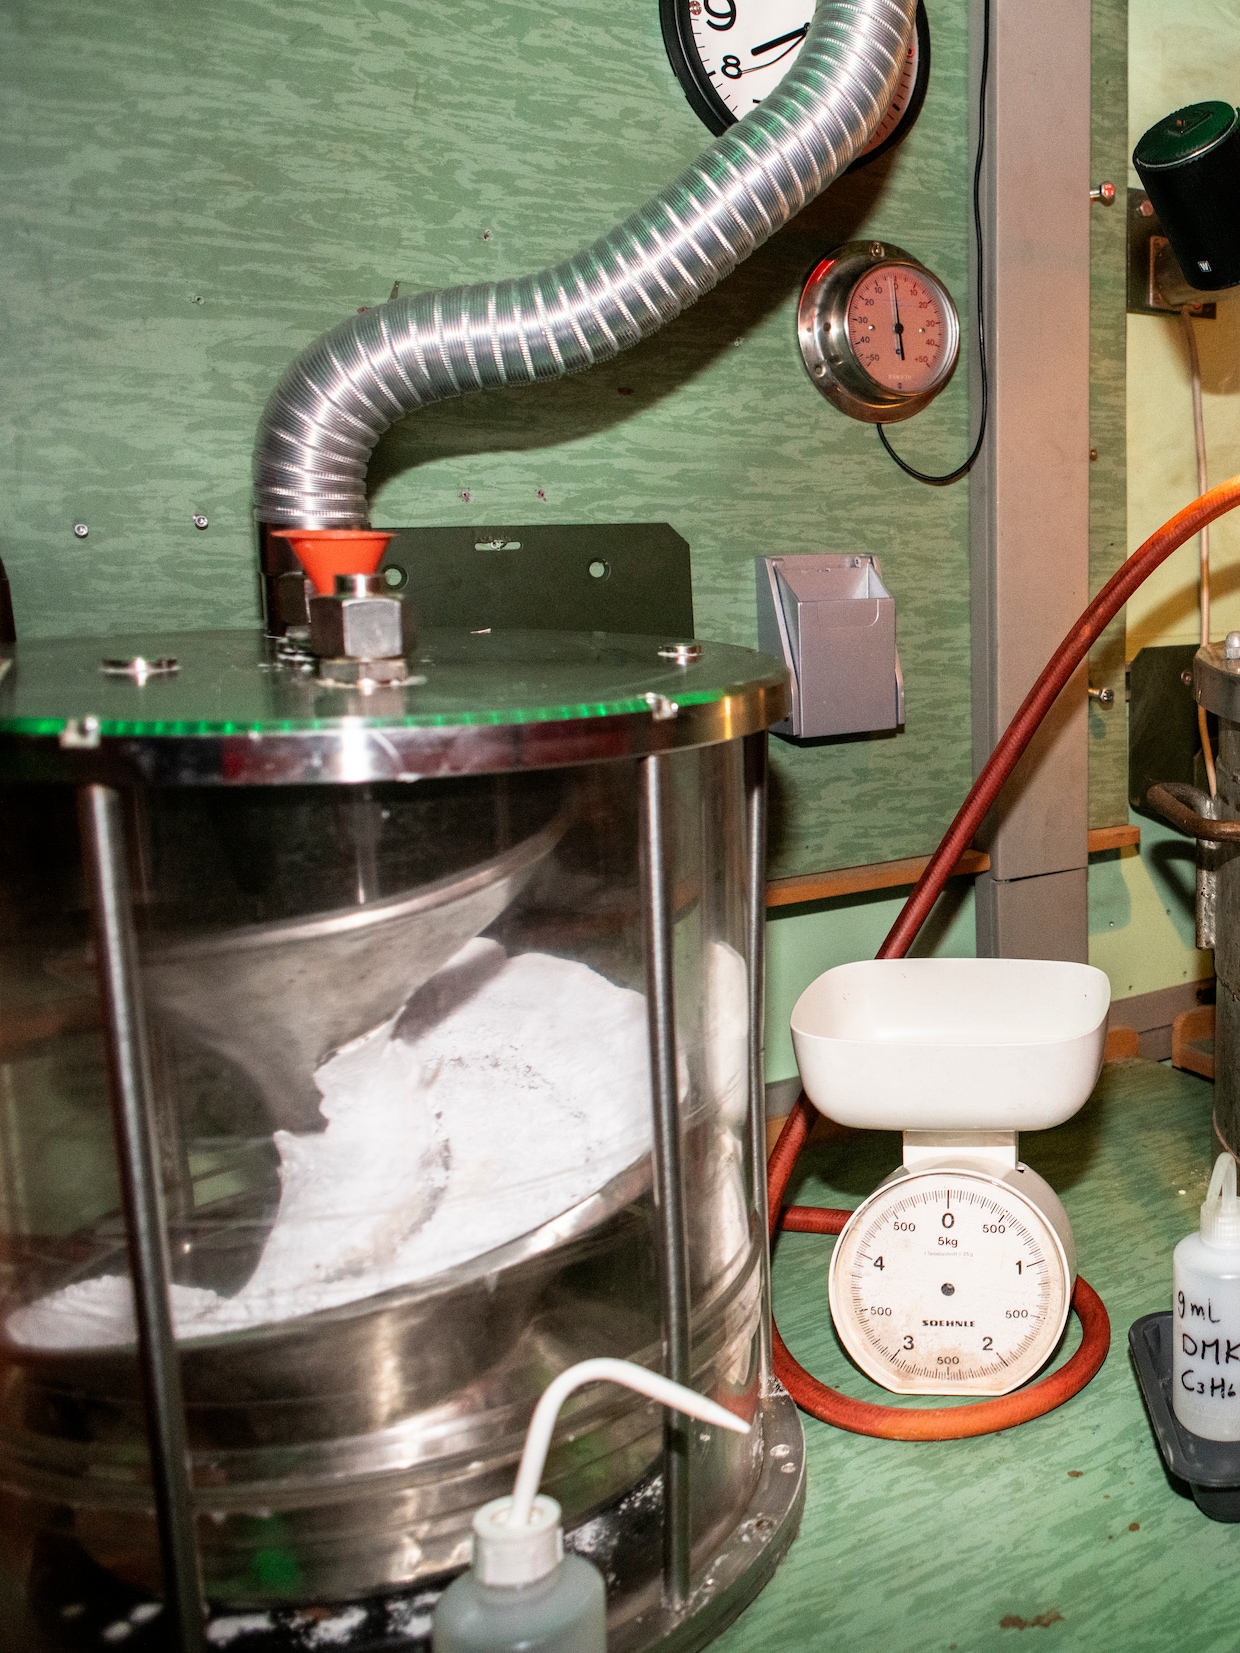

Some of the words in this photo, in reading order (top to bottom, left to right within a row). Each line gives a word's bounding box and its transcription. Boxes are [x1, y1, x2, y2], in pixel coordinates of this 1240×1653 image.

[704, 0, 737, 31] 9
[721, 55, 743, 79] 8
[865, 298, 875, 306] 20
[919, 301, 928, 309] 20
[858, 316, 868, 324] 30
[941, 1212, 955, 1229] 0
[893, 1221, 916, 1232] 500
[982, 1224, 1006, 1234] 500
[873, 1256, 885, 1271] 4
[1015, 1260, 1022, 1275] 1
[870, 1306, 892, 1317] 500
[1005, 1309, 1029, 1319] 500
[903, 1335, 915, 1350] 3
[982, 1336, 993, 1351] 2
[936, 1356, 960, 1365] 500
